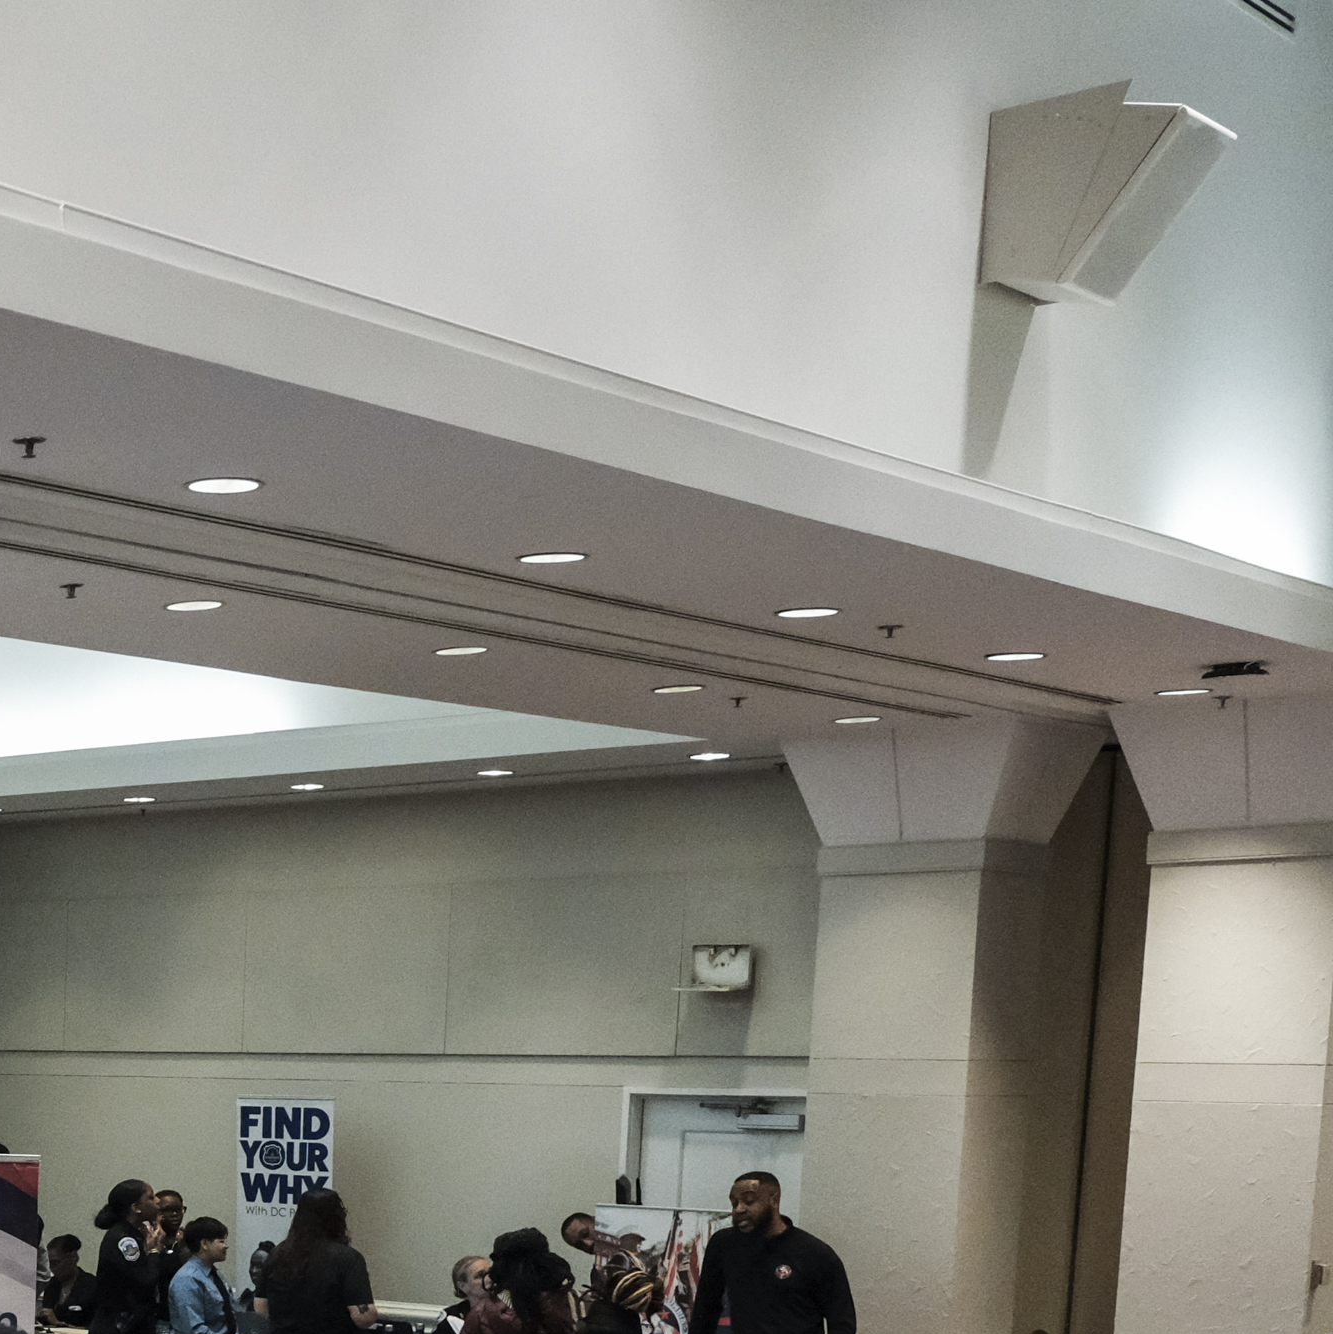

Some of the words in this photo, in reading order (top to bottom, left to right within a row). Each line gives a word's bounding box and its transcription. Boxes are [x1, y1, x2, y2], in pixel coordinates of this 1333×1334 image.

[240, 1106, 331, 1141] FIND
[245, 1205, 268, 1216] With
[270, 1206, 287, 1217] DC
